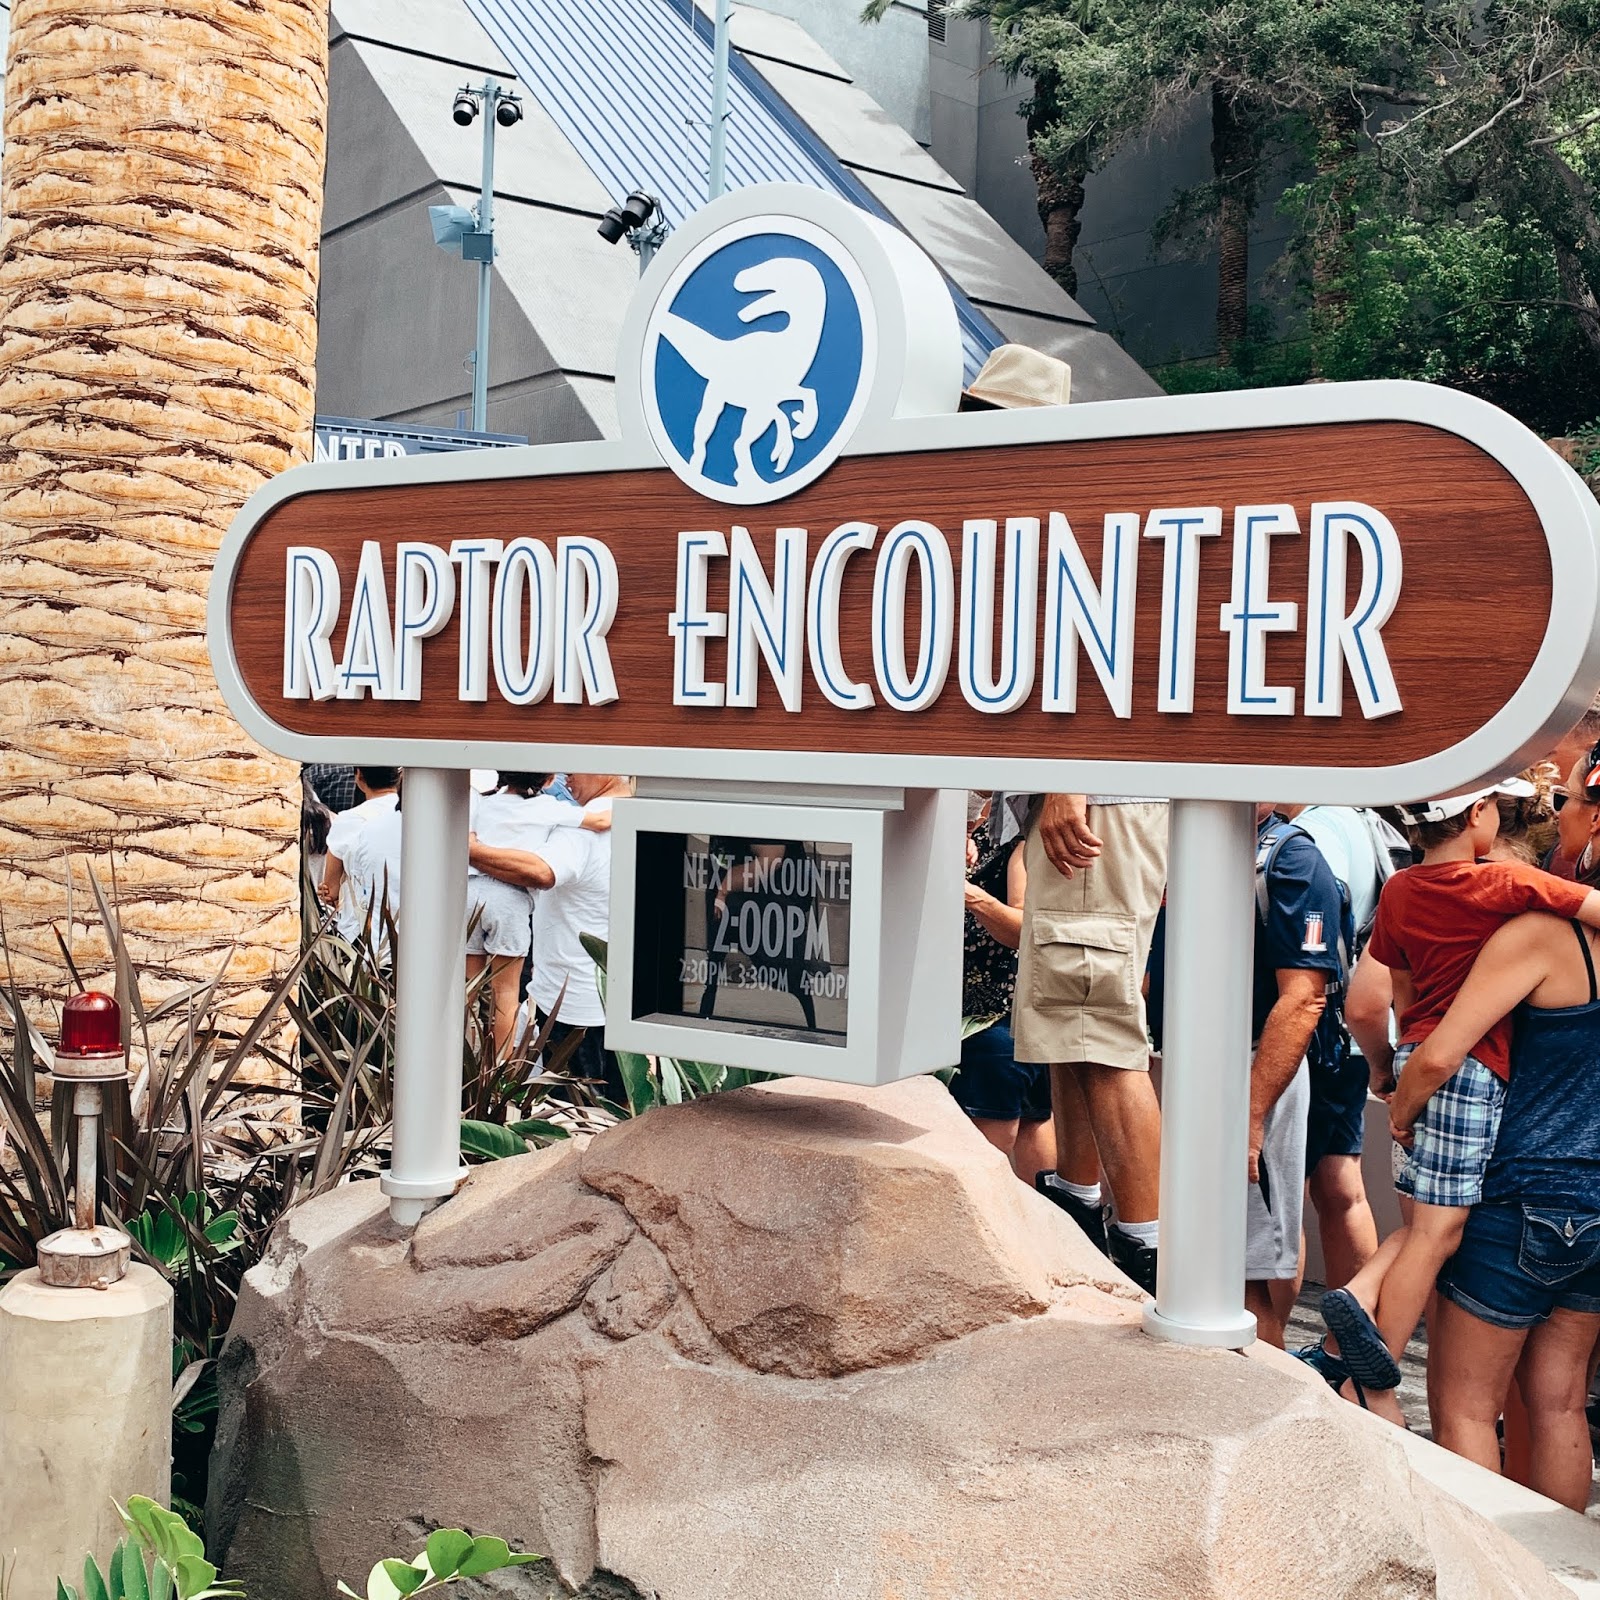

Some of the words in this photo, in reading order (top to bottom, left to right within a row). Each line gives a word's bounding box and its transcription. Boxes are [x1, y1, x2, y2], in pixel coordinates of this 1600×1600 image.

[283, 536, 619, 706] RAPTOR
[668, 501, 1403, 720] ENCOUNTER
[683, 851, 735, 891] NEXT
[713, 900, 831, 963] 2:00PM
[679, 958, 728, 986] 2:30PM
[738, 963, 789, 993] 3:30PM
[800, 970, 848, 999] 4:00P
